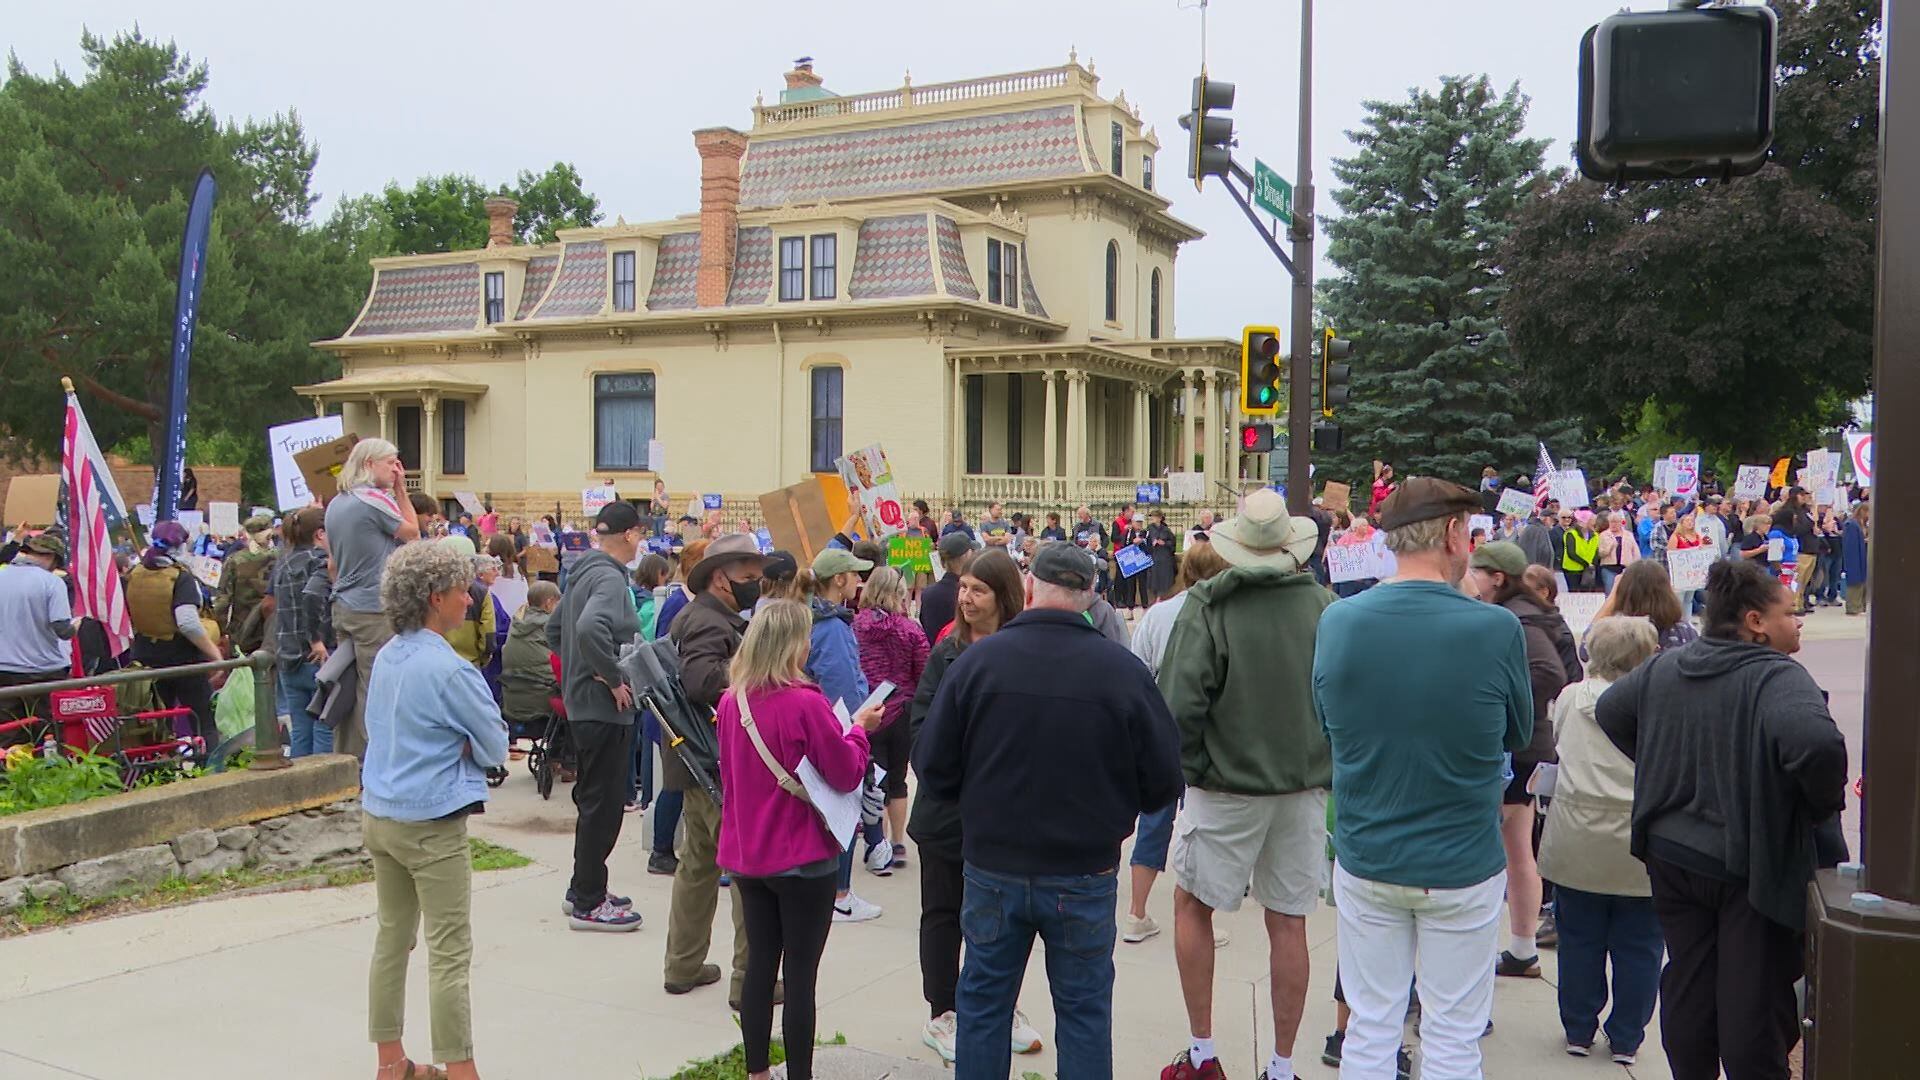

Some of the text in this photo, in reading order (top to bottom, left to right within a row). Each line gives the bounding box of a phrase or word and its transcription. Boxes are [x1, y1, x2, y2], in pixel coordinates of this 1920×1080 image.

[1256, 170, 1263, 197] S
[1264, 176, 1285, 212] Broad
[904, 539, 922, 549] NO
